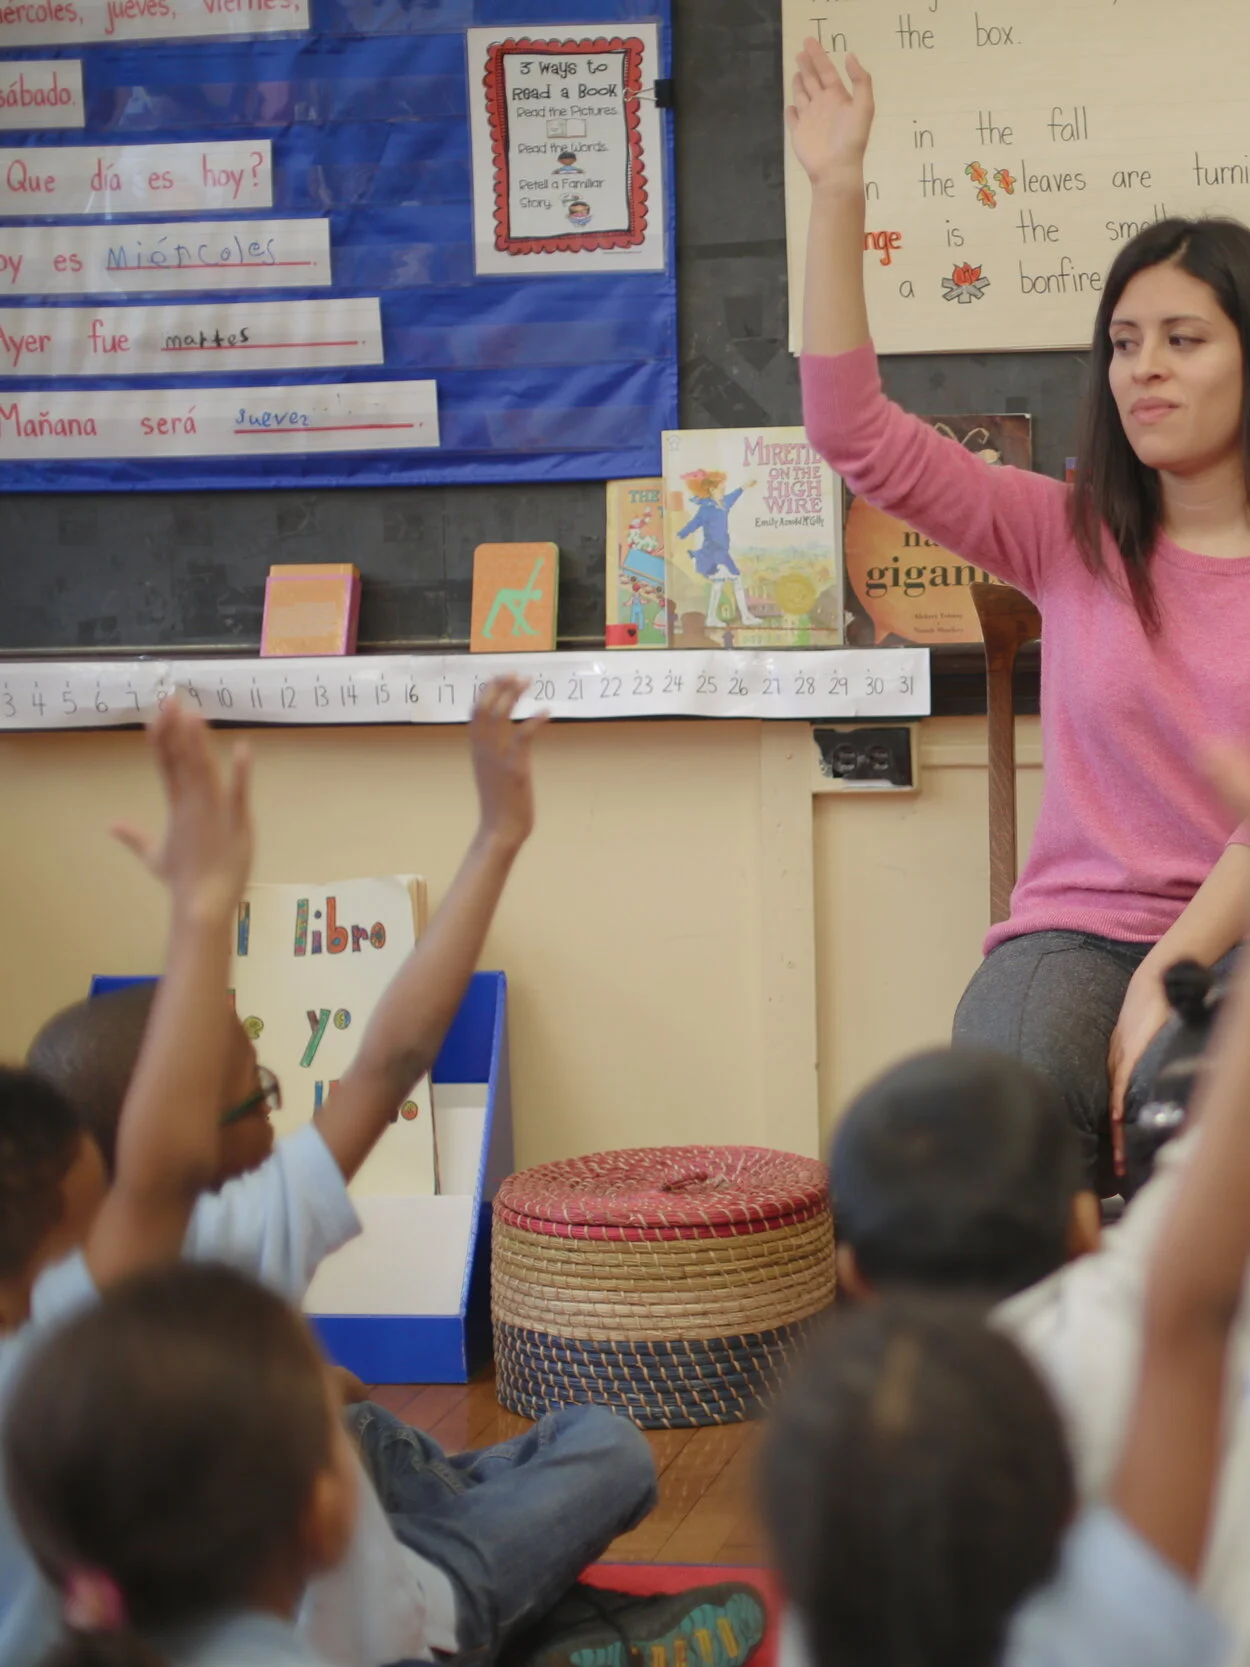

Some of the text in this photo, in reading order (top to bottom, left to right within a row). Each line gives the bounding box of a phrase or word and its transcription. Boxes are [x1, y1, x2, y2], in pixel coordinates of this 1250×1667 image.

[104, 0, 177, 35] jueves,
[808, 12, 1023, 53] In the box.
[519, 59, 608, 79] 3 Ways to
[511, 83, 618, 101] Read a Book
[516, 105, 546, 118] Read
[549, 105, 567, 117] the
[912, 106, 1088, 148] in the fall
[517, 142, 547, 154] Read
[550, 142, 568, 153] the
[6, 152, 264, 200] Que día es hoy?
[518, 178, 605, 191] Retell a Familiar
[918, 162, 956, 198] the
[1021, 160, 1087, 194] leaves
[1111, 169, 1153, 189] are
[945, 218, 966, 248] is
[1015, 208, 1060, 244] the
[53, 253, 84, 272] es
[898, 255, 1103, 298] a bonfire
[87, 318, 131, 354] fue
[140, 405, 196, 436] será
[766, 479, 822, 499] HIGH
[768, 465, 822, 480] ON THE
[627, 489, 660, 504] THE
[762, 496, 824, 515] WIRE
[865, 555, 996, 599] gigan
[3, 692, 17, 718] 3
[31, 692, 47, 717] 4
[62, 690, 78, 715] 5
[95, 690, 109, 713] 6
[125, 691, 140, 712] 7
[188, 687, 202, 708] 9
[216, 687, 234, 708] 10
[250, 688, 264, 709] 11
[281, 686, 298, 709] 12
[314, 686, 330, 708] 13
[340, 684, 358, 708] 14
[374, 683, 391, 706] 15
[404, 683, 420, 705] 16
[438, 684, 455, 705] 17
[533, 680, 555, 702] 20
[567, 678, 584, 700] 21
[600, 676, 623, 698] 22
[632, 675, 654, 696] 23
[661, 674, 685, 694] 24
[695, 675, 718, 695] 25
[727, 677, 749, 697] 26
[761, 677, 781, 696] 27
[794, 676, 816, 696] 28
[828, 677, 849, 696] 29
[865, 676, 885, 696] 30
[900, 675, 915, 696] 31
[293, 895, 387, 957] libro
[299, 1007, 352, 1069] yo
